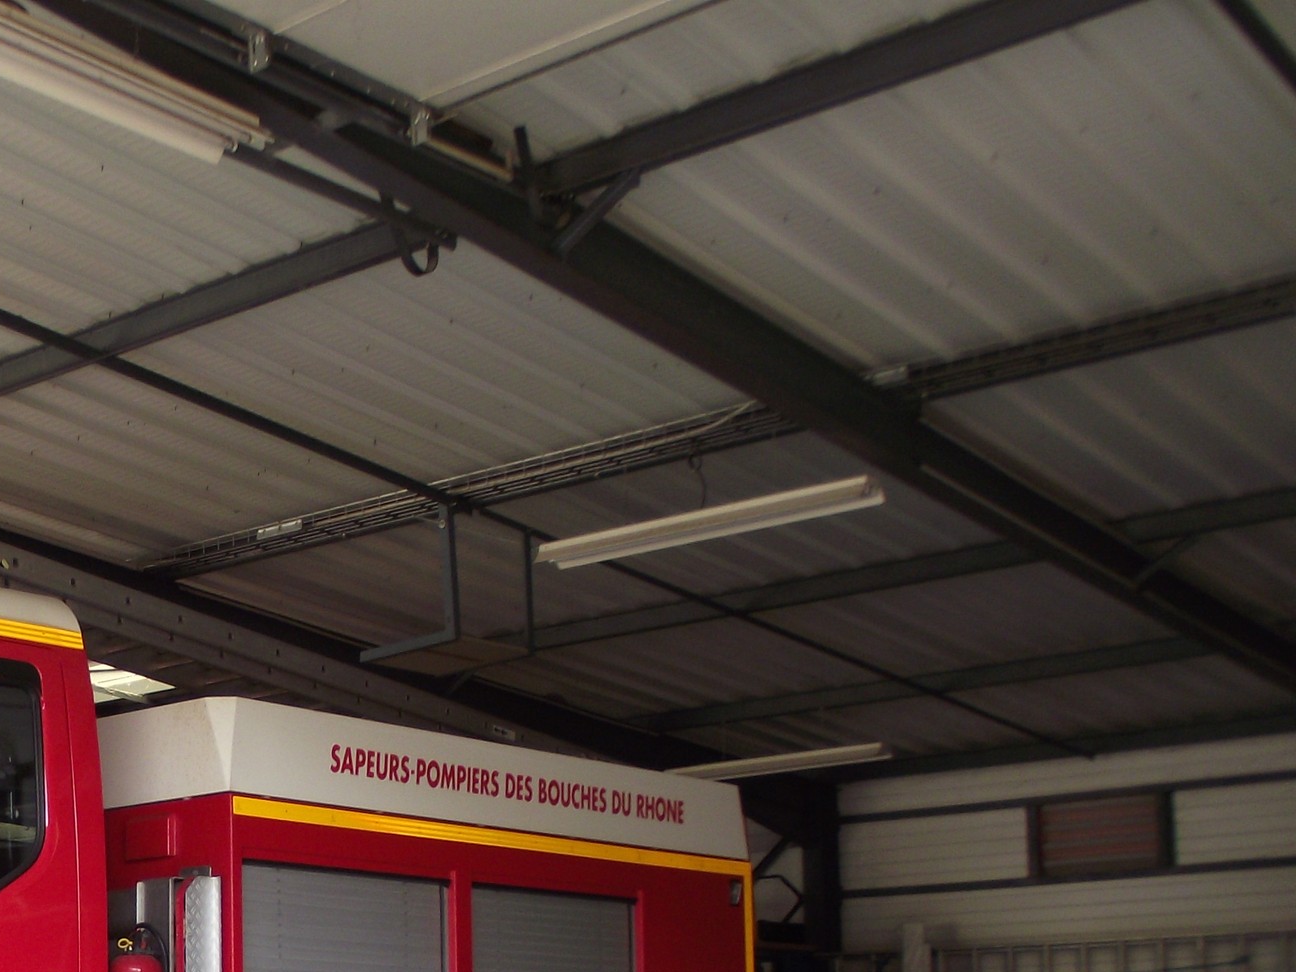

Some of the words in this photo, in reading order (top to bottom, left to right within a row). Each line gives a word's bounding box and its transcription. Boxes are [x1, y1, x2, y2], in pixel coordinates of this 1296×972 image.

[329, 743, 500, 797] SAPEURS-POMPIERS
[505, 772, 534, 802] DES
[538, 778, 607, 813] BOUCHES
[611, 789, 632, 817] DU
[636, 794, 685, 824] RHONE
